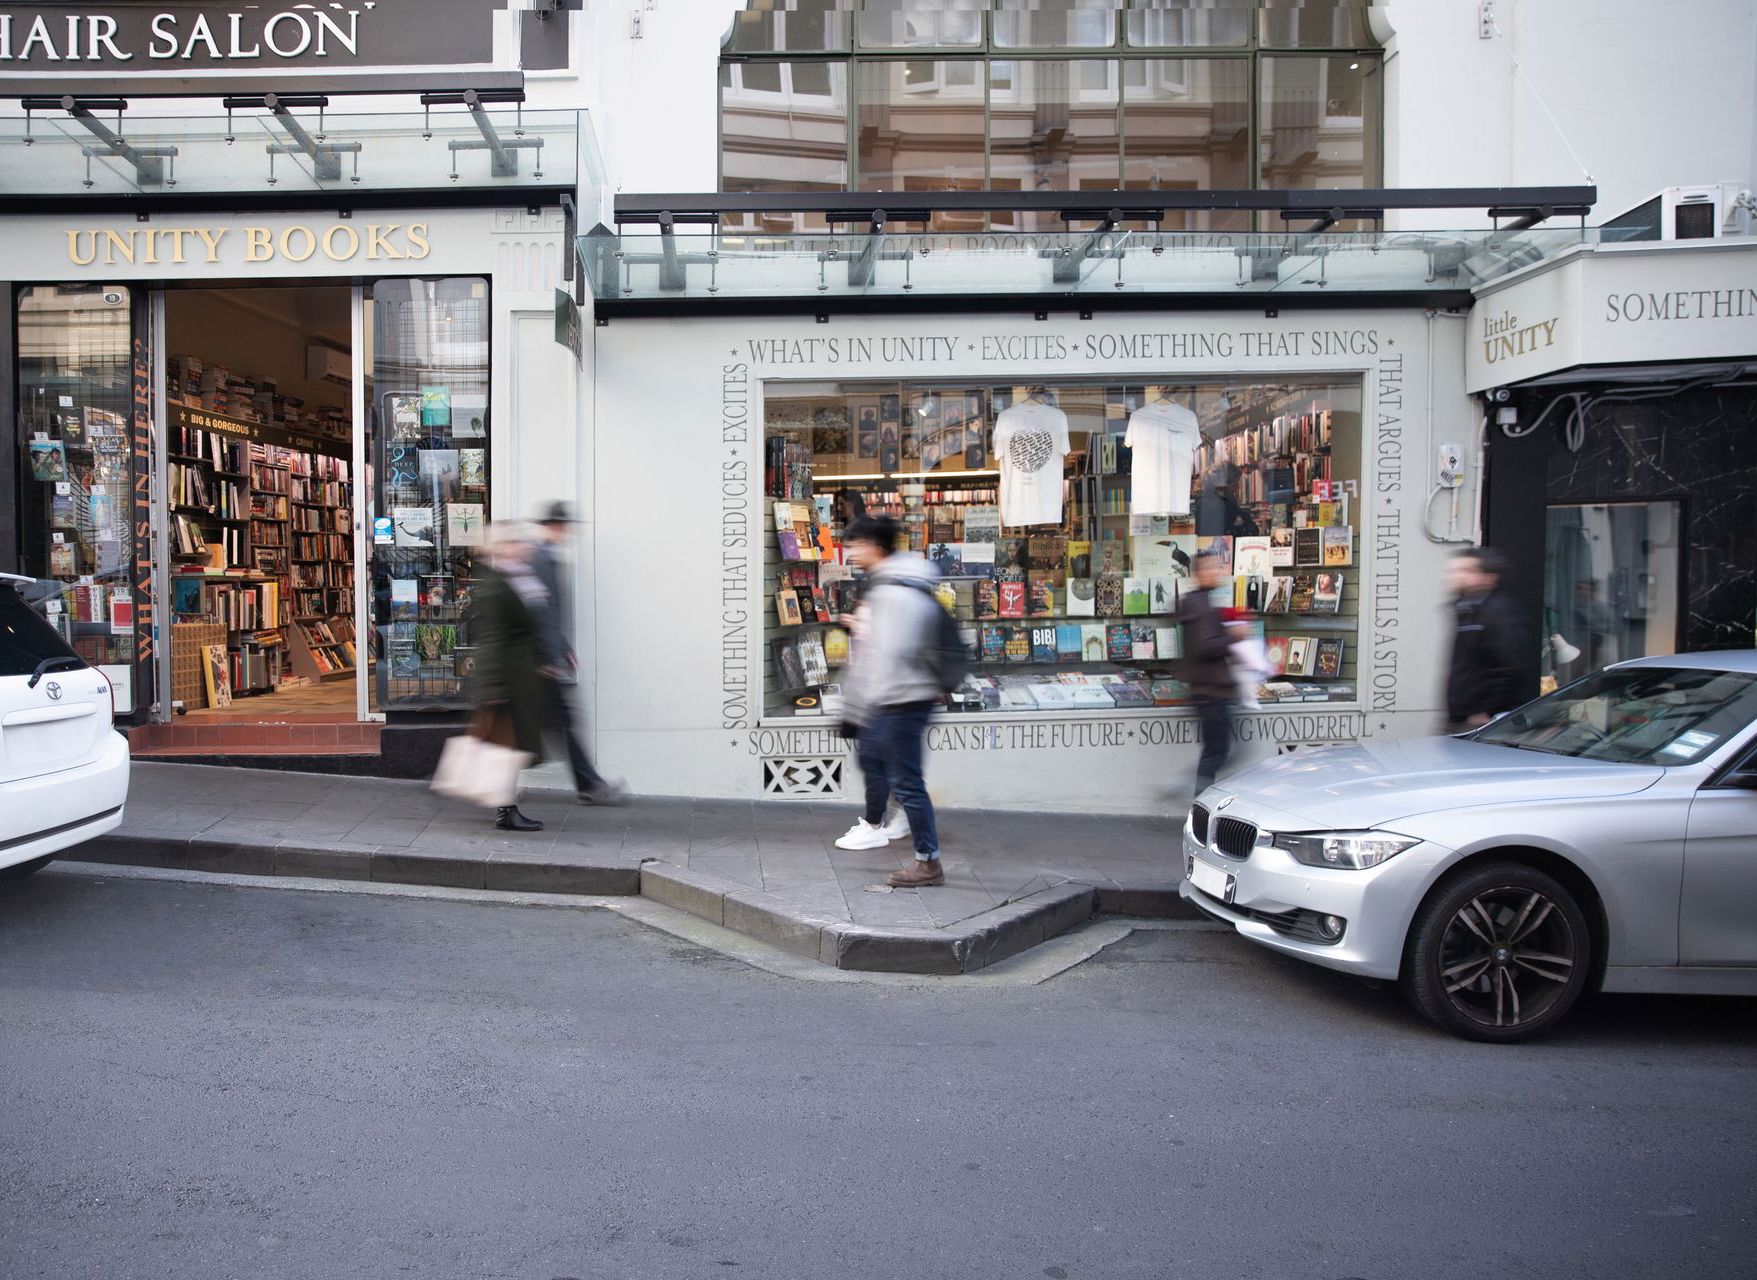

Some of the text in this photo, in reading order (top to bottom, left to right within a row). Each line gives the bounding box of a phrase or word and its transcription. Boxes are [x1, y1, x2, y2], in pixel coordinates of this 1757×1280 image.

[0, 10, 360, 61] AIR SALON
[64, 223, 432, 265] UNITY BOOKS
[1482, 317, 1559, 365] UNITY
[1483, 310, 1518, 338] little
[746, 329, 1379, 364] WHAT'S IN UNITY EXCITES SOMETHING THAT SINGS
[190, 413, 249, 436] BIG & GORGEOUS
[134, 337, 153, 663] WHAT'S IN HERE?
[722, 363, 748, 730] SOMETHING THAT SEDUCES EXCITES
[1372, 353, 1403, 714] THAT ARGUES THAT TELLS A STORY
[1032, 628, 1056, 646] BIBI
[749, 727, 861, 756] SOMETHIN
[926, 725, 968, 752] CAN
[1007, 723, 1047, 750] THE
[1050, 721, 1125, 749] FUTURE
[1138, 717, 1254, 746] SOMETNG
[1255, 713, 1373, 742] WONDERFUL
